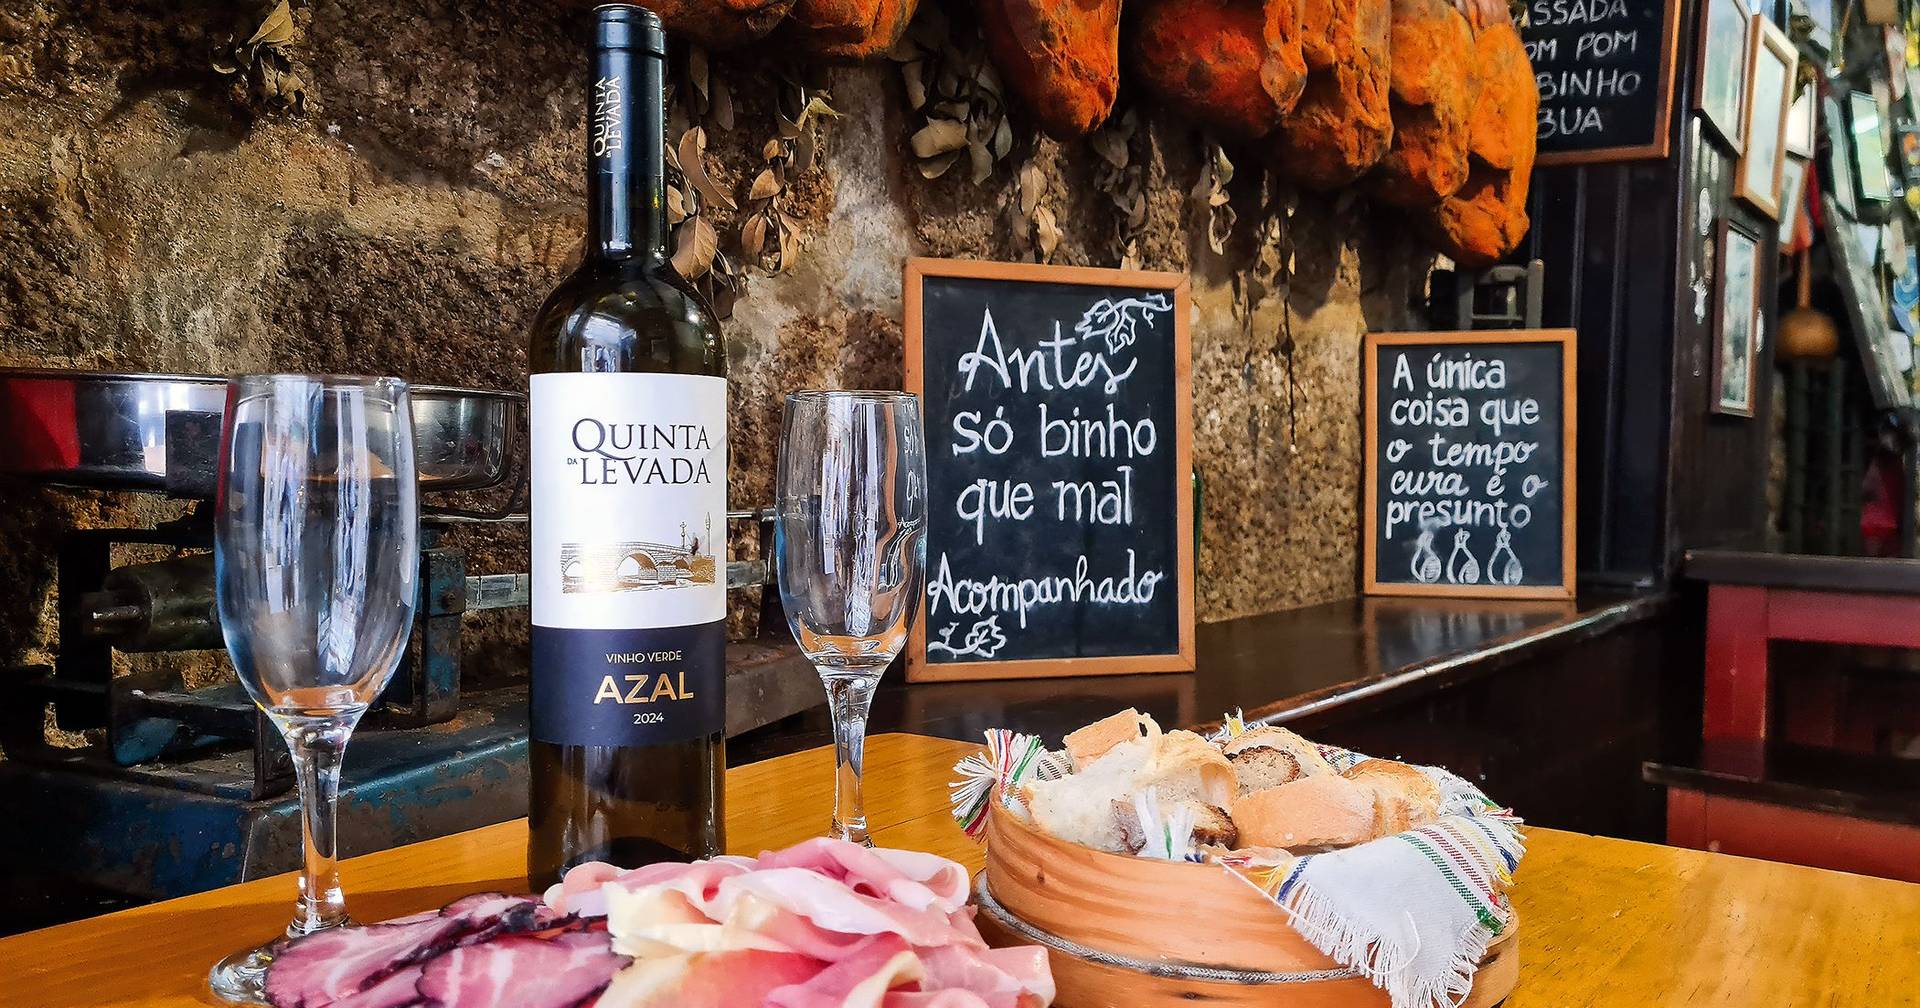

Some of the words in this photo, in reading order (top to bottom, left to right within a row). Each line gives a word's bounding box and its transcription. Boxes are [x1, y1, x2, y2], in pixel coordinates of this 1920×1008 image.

[1532, 0, 1629, 25] SSADA
[1575, 29, 1637, 61] POM
[593, 76, 608, 157] QUINTA
[606, 76, 621, 149] LEVADA
[958, 305, 1137, 394] Antes
[1393, 352, 1414, 391] A
[1427, 352, 1506, 390] única
[952, 406, 1014, 456] só
[1038, 403, 1157, 458] binho
[1390, 391, 1469, 426] coisa
[1480, 398, 1539, 436] que
[571, 417, 711, 461] QUINTA
[1386, 438, 1413, 463] o
[1428, 432, 1539, 473] tempo
[567, 457, 578, 465] DA
[580, 457, 712, 485] LEVADA
[1390, 469, 1470, 496] cura
[1486, 468, 1507, 496] é
[1522, 474, 1549, 498] o
[956, 478, 1034, 545] que
[1052, 465, 1134, 525] mal
[1385, 499, 1532, 539] presunto
[927, 548, 1164, 629] Acompanhado
[606, 652, 645, 664] VINHO
[647, 650, 682, 662] VERDE
[593, 671, 694, 704] AZAL
[633, 712, 664, 724] 2024
